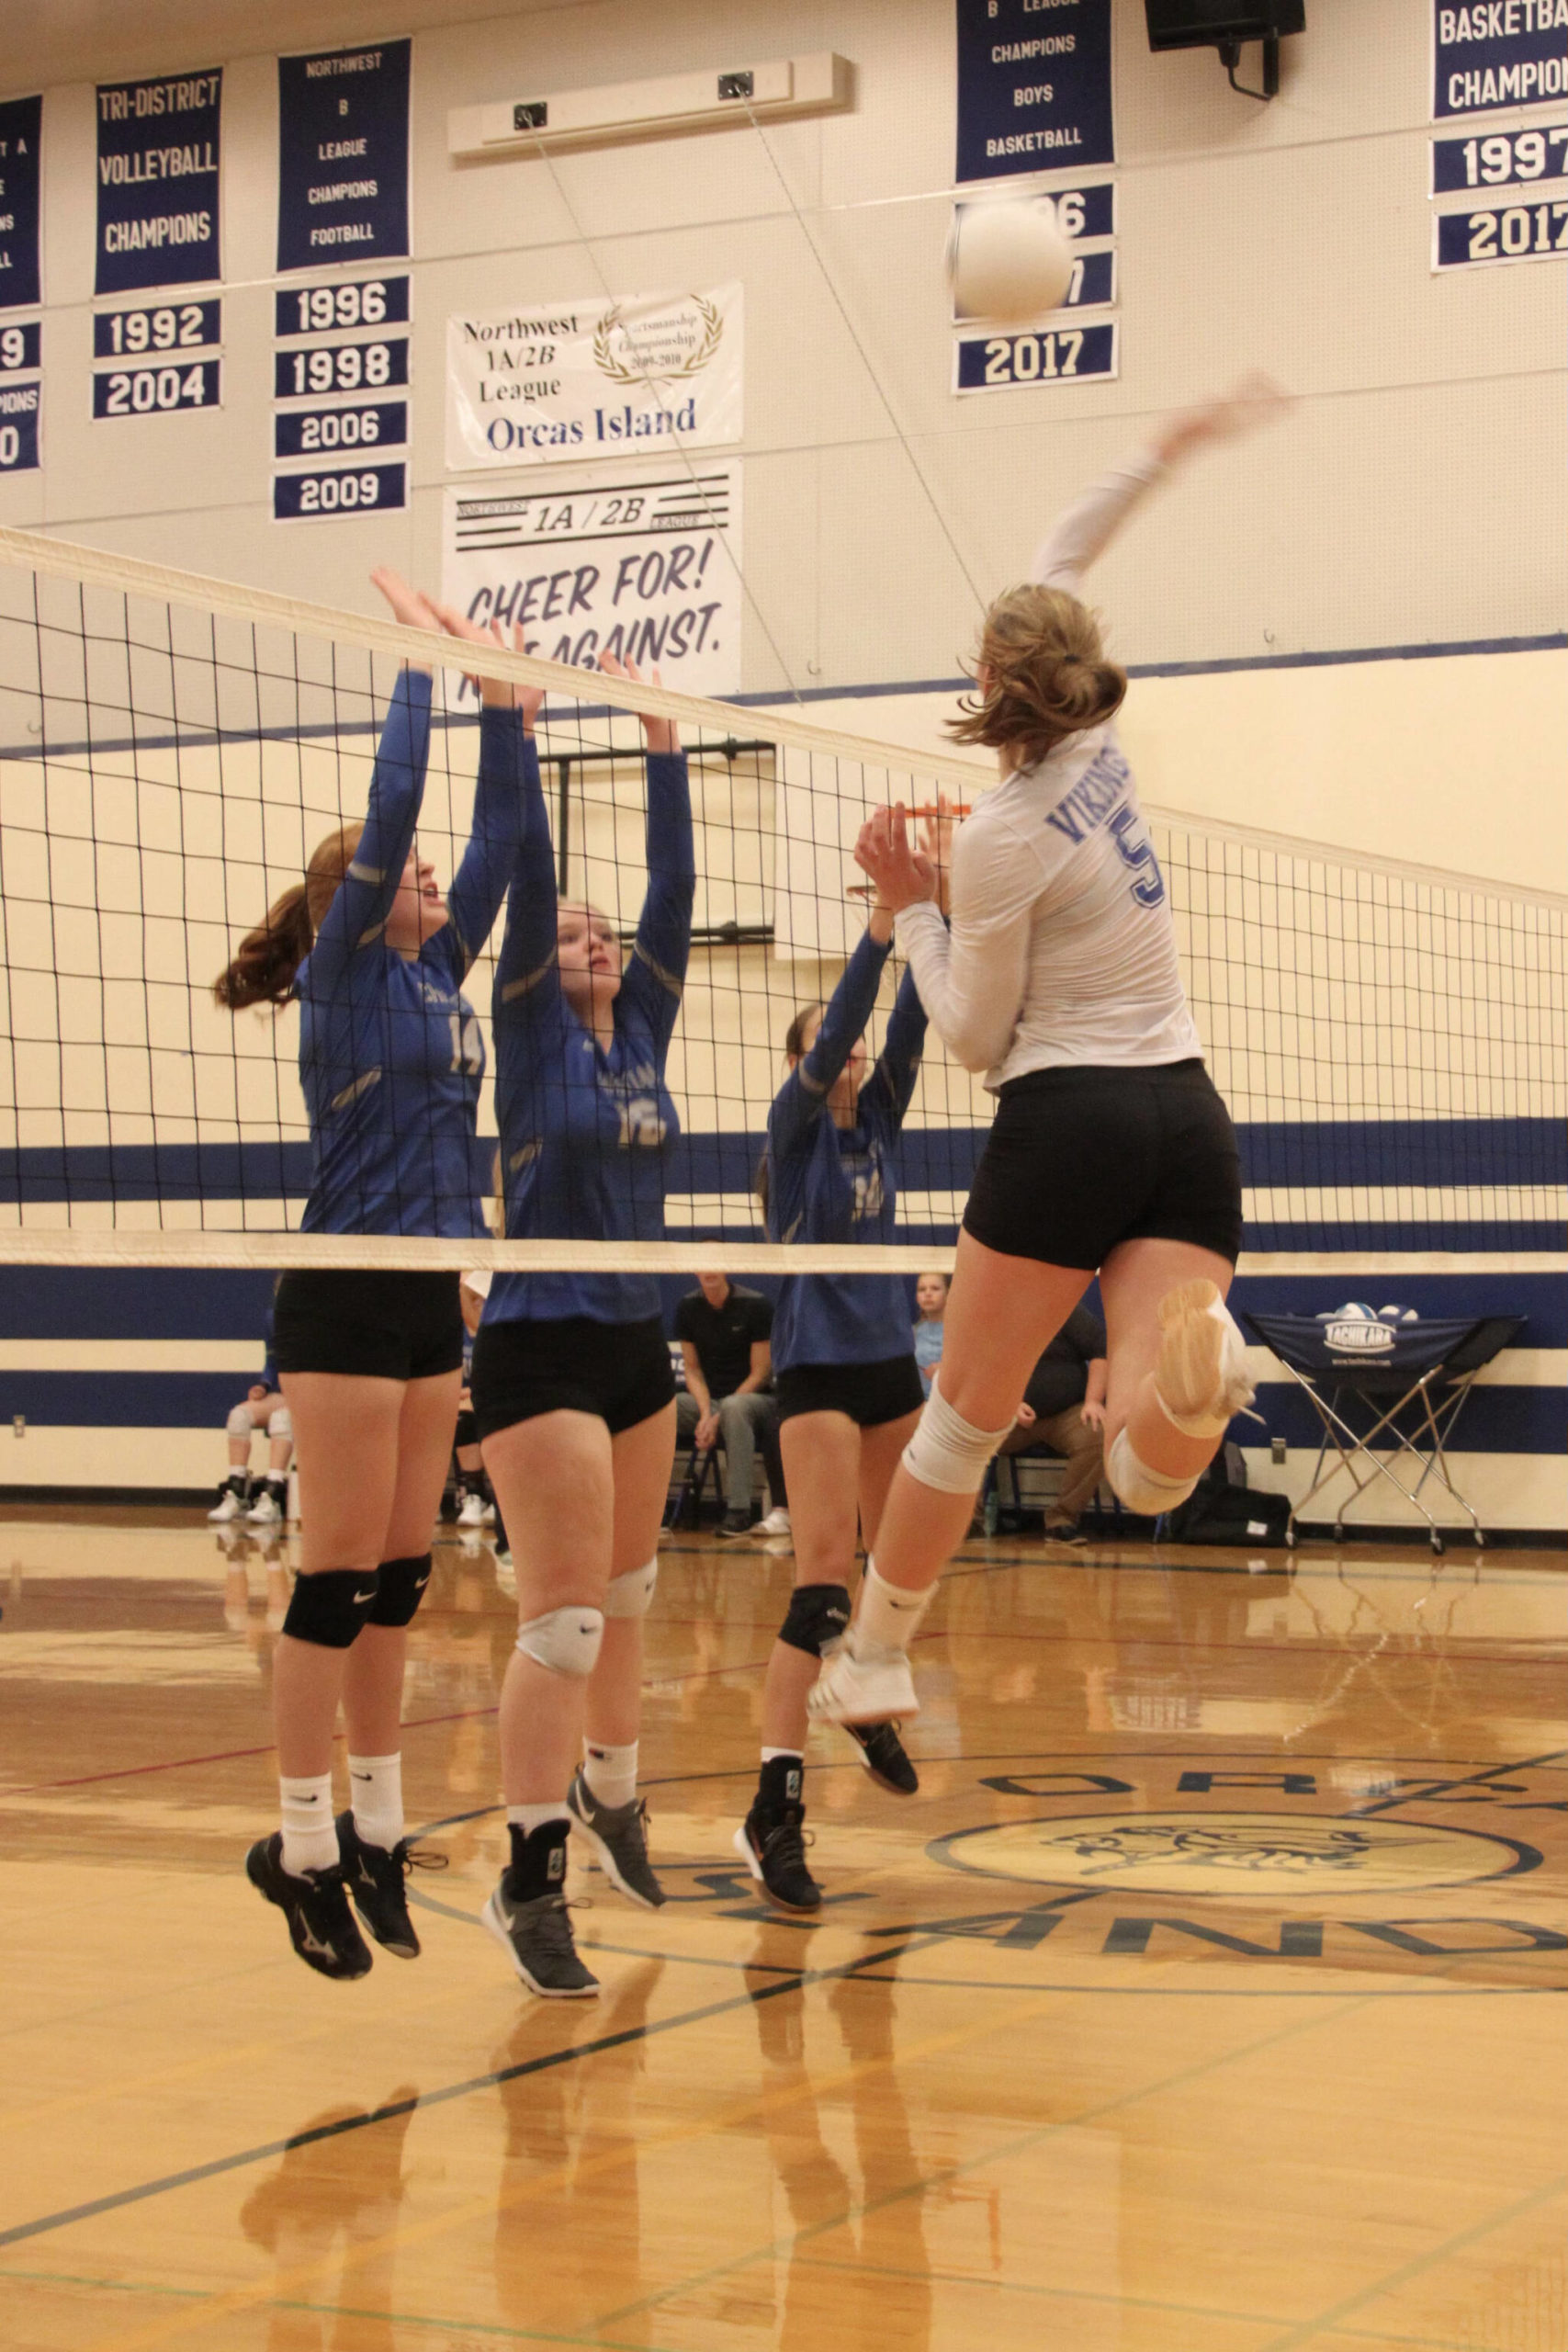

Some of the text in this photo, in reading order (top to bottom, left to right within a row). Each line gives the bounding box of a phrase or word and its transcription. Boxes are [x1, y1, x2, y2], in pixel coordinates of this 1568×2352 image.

[306, 51, 383, 78] NORTHWEST
[991, 34, 1077, 63] CHAMPIONS
[99, 76, 220, 121] TRI-DISTRICT
[1013, 84, 1054, 107] BOYS
[1449, 56, 1568, 108] CHAMPIO
[339, 98, 348, 116] B
[318, 138, 367, 161] LEAGUE
[986, 127, 1082, 157] BASKETBALL
[99, 141, 218, 186] VOLLEYBALL
[308, 180, 378, 205] CHAMPIONS
[105, 210, 211, 254] CHAMPIONS
[310, 222, 375, 246] FOOTBALL
[298, 282, 386, 331] 1996
[110, 306, 204, 354] 1992
[464, 315, 579, 343] Northwest
[293, 344, 390, 393] 1998
[487, 345, 556, 372] 1A/2B
[985, 330, 1085, 384] 2017
[107, 365, 205, 414] 2004
[479, 378, 561, 404] League
[301, 410, 379, 449] 2006
[487, 398, 696, 451] Orcas Island
[299, 472, 379, 511] 2009
[467, 537, 714, 628] CHEER FOR!
[1104, 799, 1166, 910] 5
